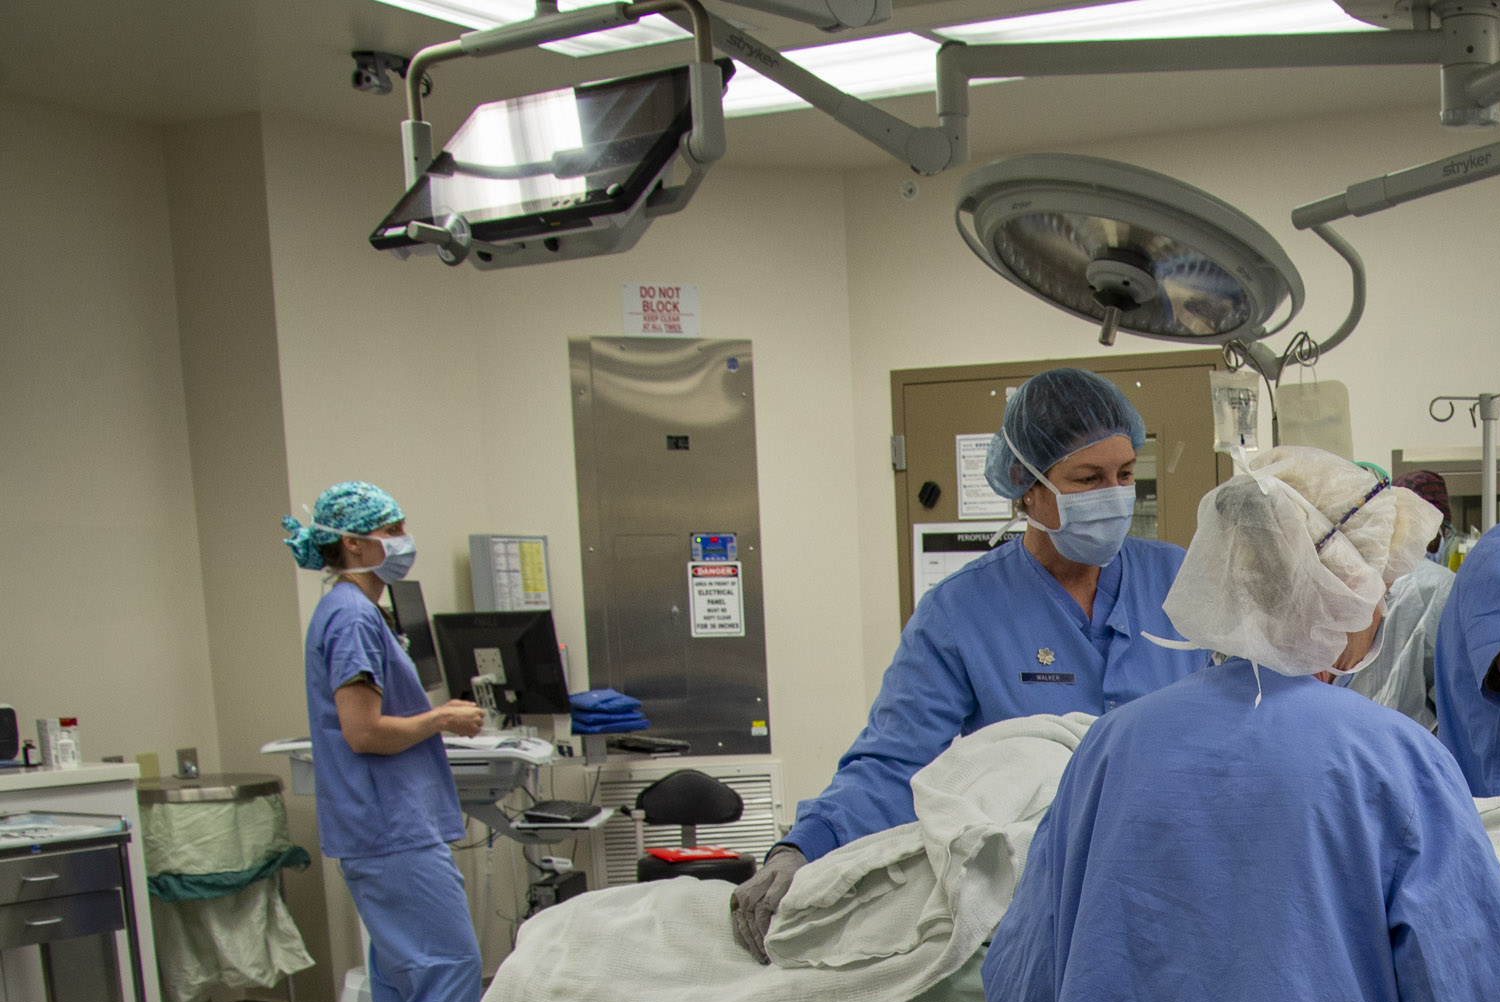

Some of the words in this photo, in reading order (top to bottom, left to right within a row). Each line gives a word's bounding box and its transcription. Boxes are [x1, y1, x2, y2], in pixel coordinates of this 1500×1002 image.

[1442, 152, 1492, 177] stryker
[640, 286, 656, 299] DO
[658, 286, 681, 299] NOT
[642, 300, 680, 313] BLOCK
[698, 567, 732, 575] DANGER
